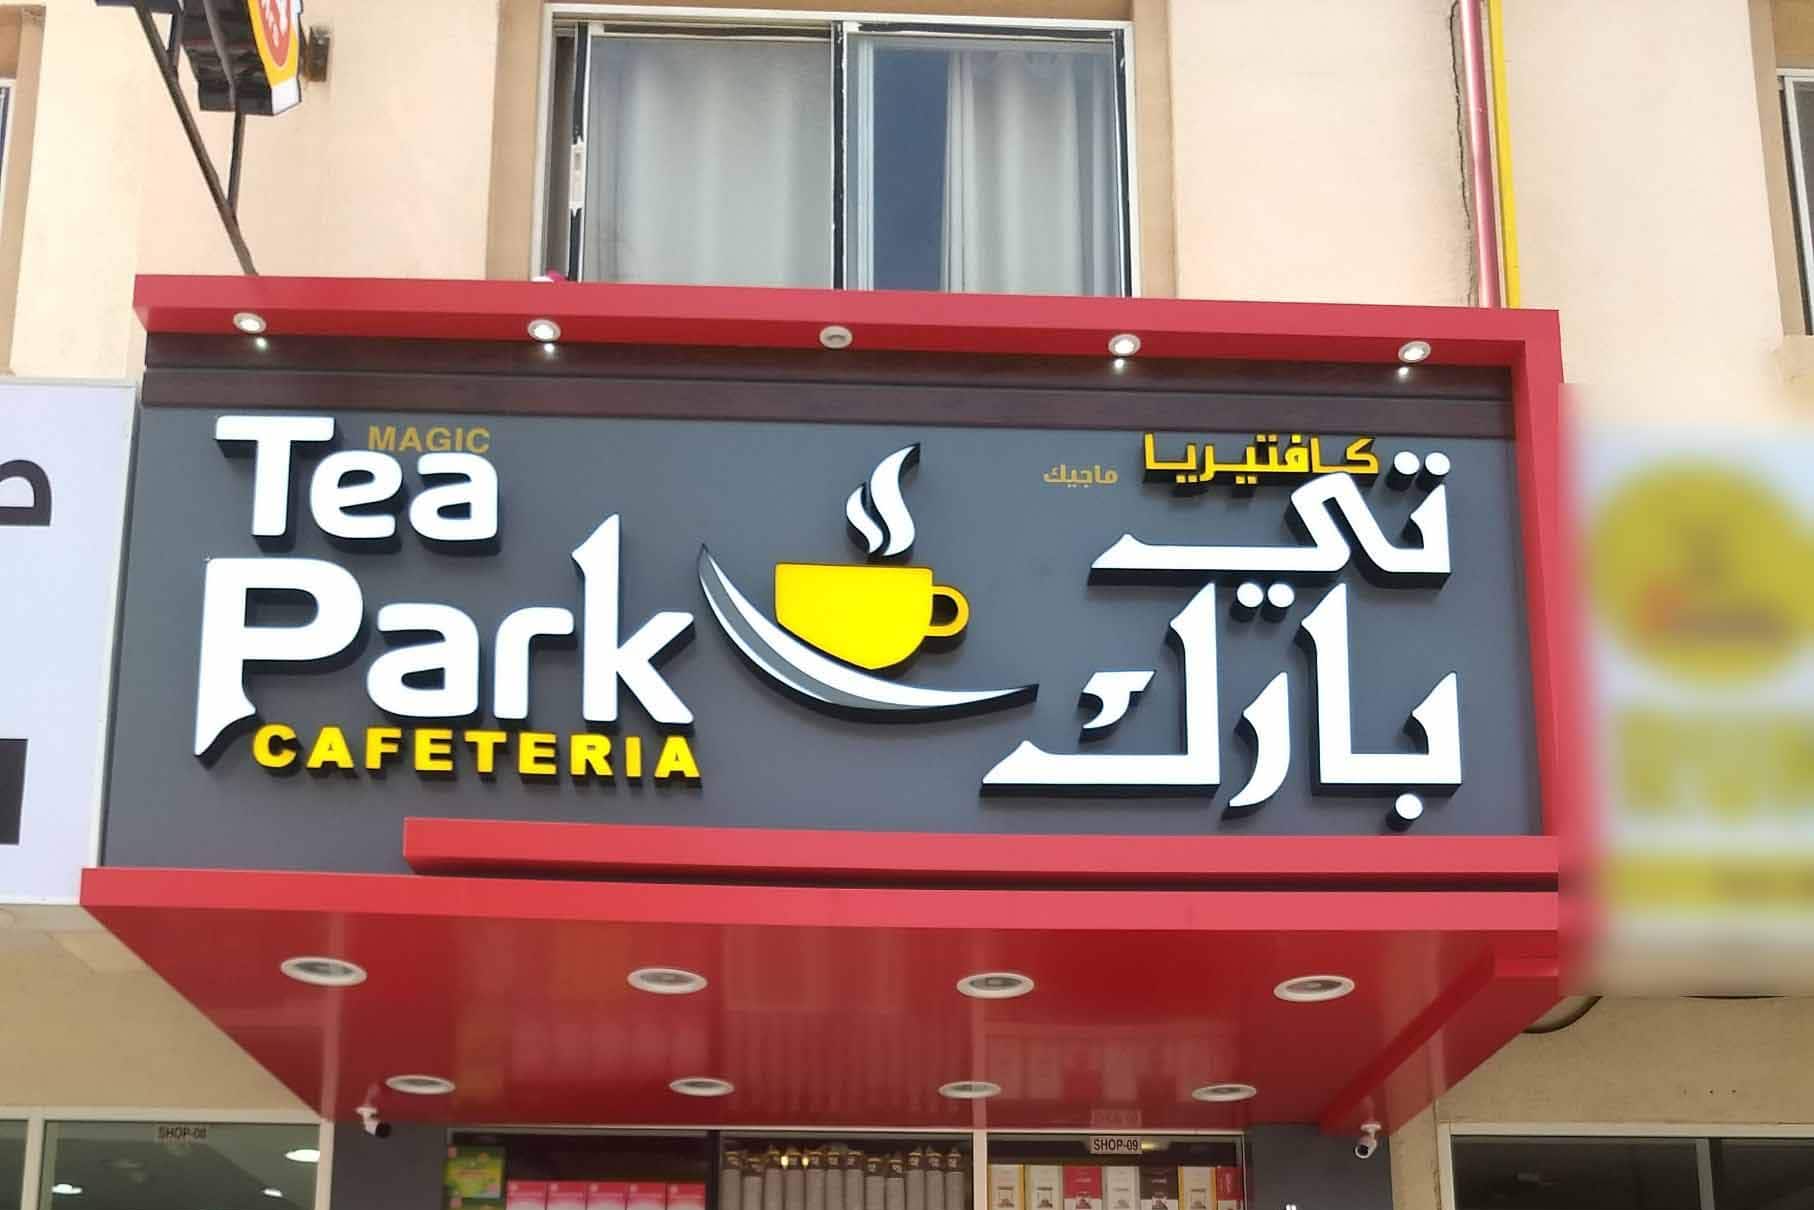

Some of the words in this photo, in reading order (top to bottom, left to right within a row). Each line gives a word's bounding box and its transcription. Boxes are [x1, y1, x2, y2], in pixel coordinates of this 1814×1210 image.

[368, 425, 491, 454] MAGIC
[1143, 432, 1380, 485] كافتيريا
[214, 415, 499, 542] Tea
[1043, 463, 1119, 488] ماجيك
[194, 513, 695, 757] Park
[982, 582, 1463, 822] بارك
[252, 723, 701, 779] CAFETERIA
[1093, 1138, 1138, 1151] SHOP-09
